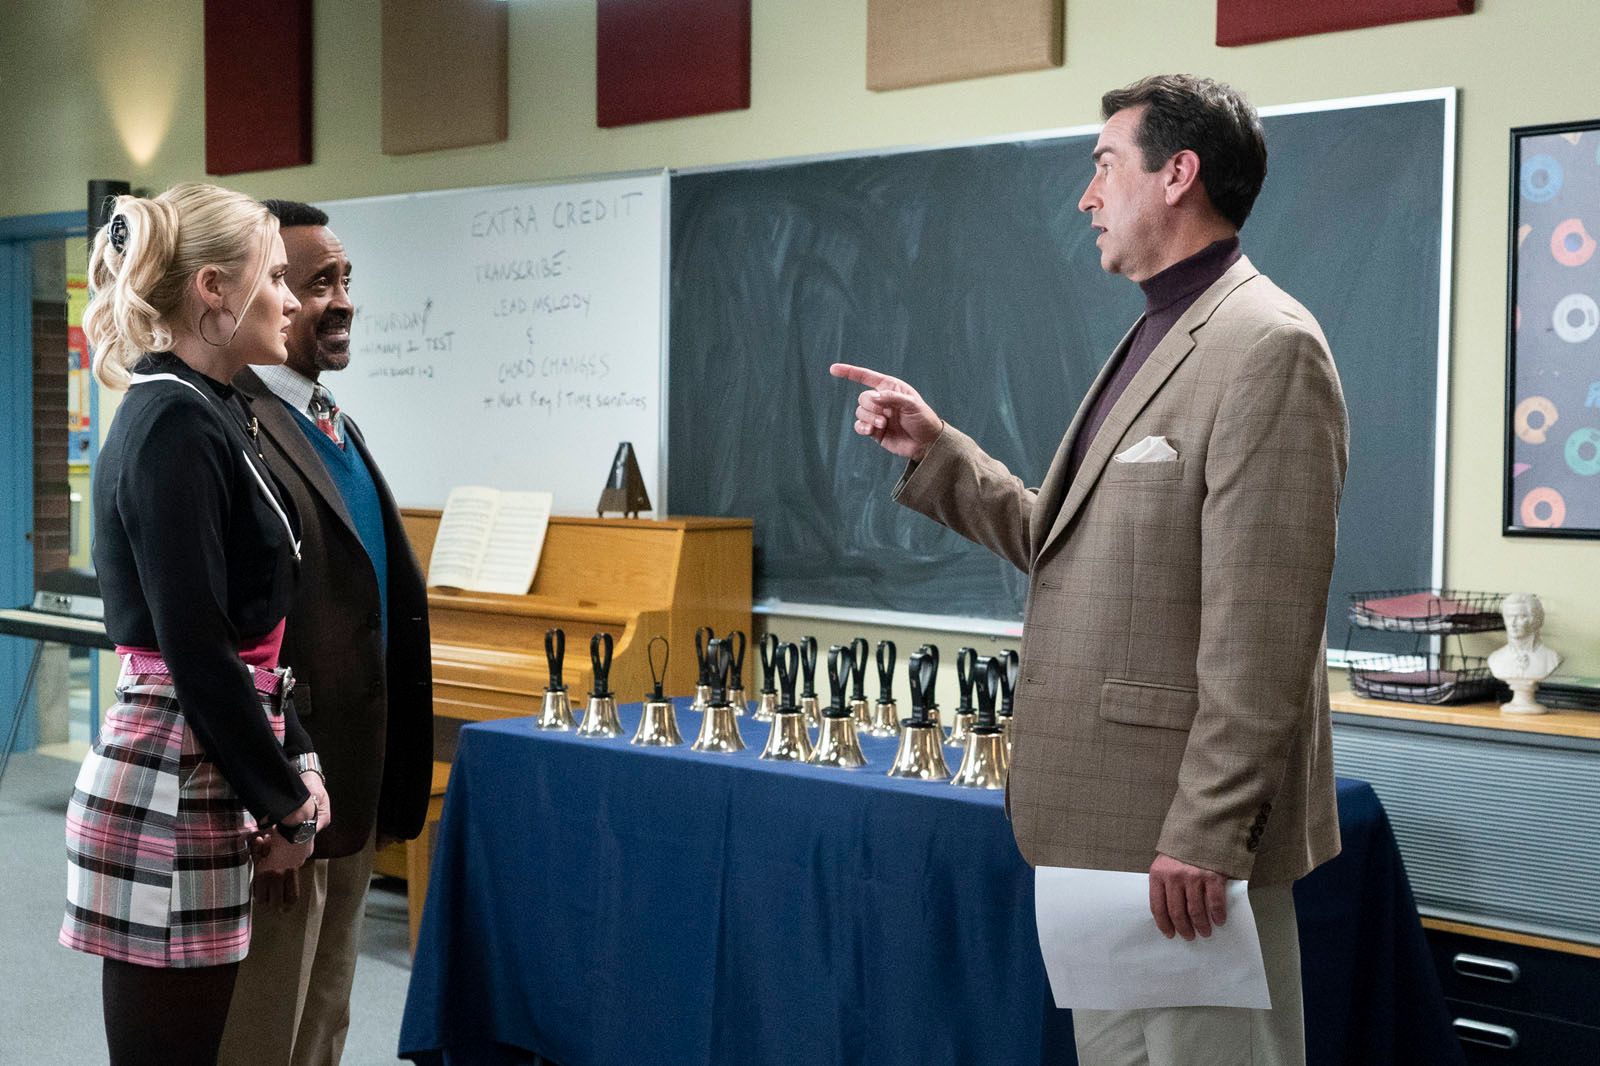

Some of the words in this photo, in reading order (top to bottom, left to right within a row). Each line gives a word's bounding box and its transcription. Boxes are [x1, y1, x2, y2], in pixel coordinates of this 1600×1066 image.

[471, 204, 539, 238] EXTRA
[552, 191, 643, 229] CREDIT
[493, 296, 527, 318] LEAD
[425, 331, 455, 352] TEST
[541, 354, 614, 380] CHANGES
